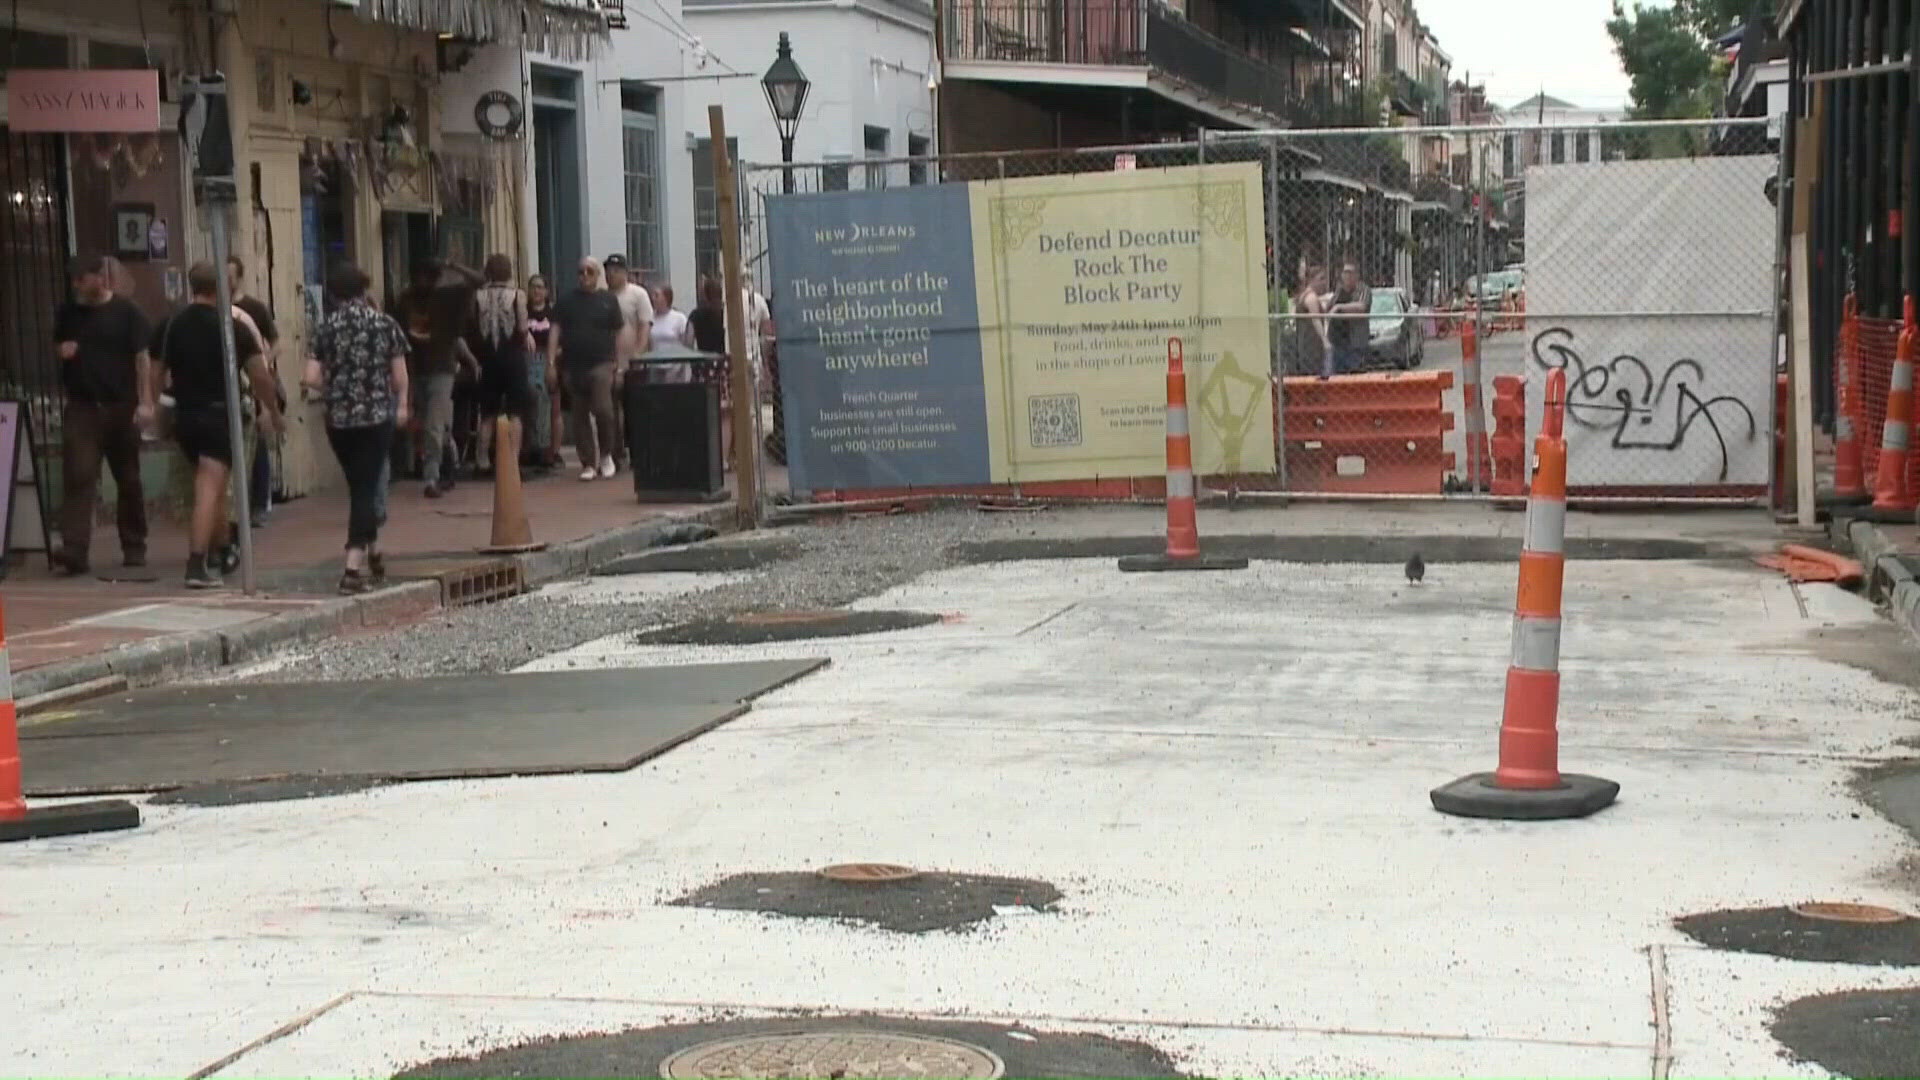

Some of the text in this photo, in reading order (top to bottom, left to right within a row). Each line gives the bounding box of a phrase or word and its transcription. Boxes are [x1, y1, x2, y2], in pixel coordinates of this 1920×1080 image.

[19, 90, 73, 111] SASSY
[815, 228, 845, 244] NEW
[1038, 227, 1201, 253] Defend Decatur
[1073, 254, 1168, 277] Rock The
[792, 271, 949, 299] The heart of the
[1064, 281, 1182, 305] Block Party
[802, 295, 943, 326] neighborhood
[818, 323, 931, 347] hasn't gone
[1081, 322, 1108, 335] May
[1111, 319, 1139, 332] 24th
[1143, 319, 1169, 332] 1pm
[1172, 318, 1185, 329] to
[1189, 315, 1222, 329] 10pm
[1053, 339, 1087, 353] Food,
[1135, 335, 1159, 348] and
[825, 347, 929, 374] anywhere!
[1035, 359, 1047, 371] in
[1050, 357, 1071, 370] the
[1074, 356, 1110, 370] shops
[1113, 353, 1126, 367] of
[1129, 351, 1167, 365] Lower
[842, 390, 919, 405] French Quarter
[820, 407, 875, 422] businesses
[877, 409, 895, 420] are
[896, 405, 914, 418] still
[811, 421, 957, 440] Support the small businesses
[830, 443, 844, 453] on
[845, 438, 895, 452] 900-1200
